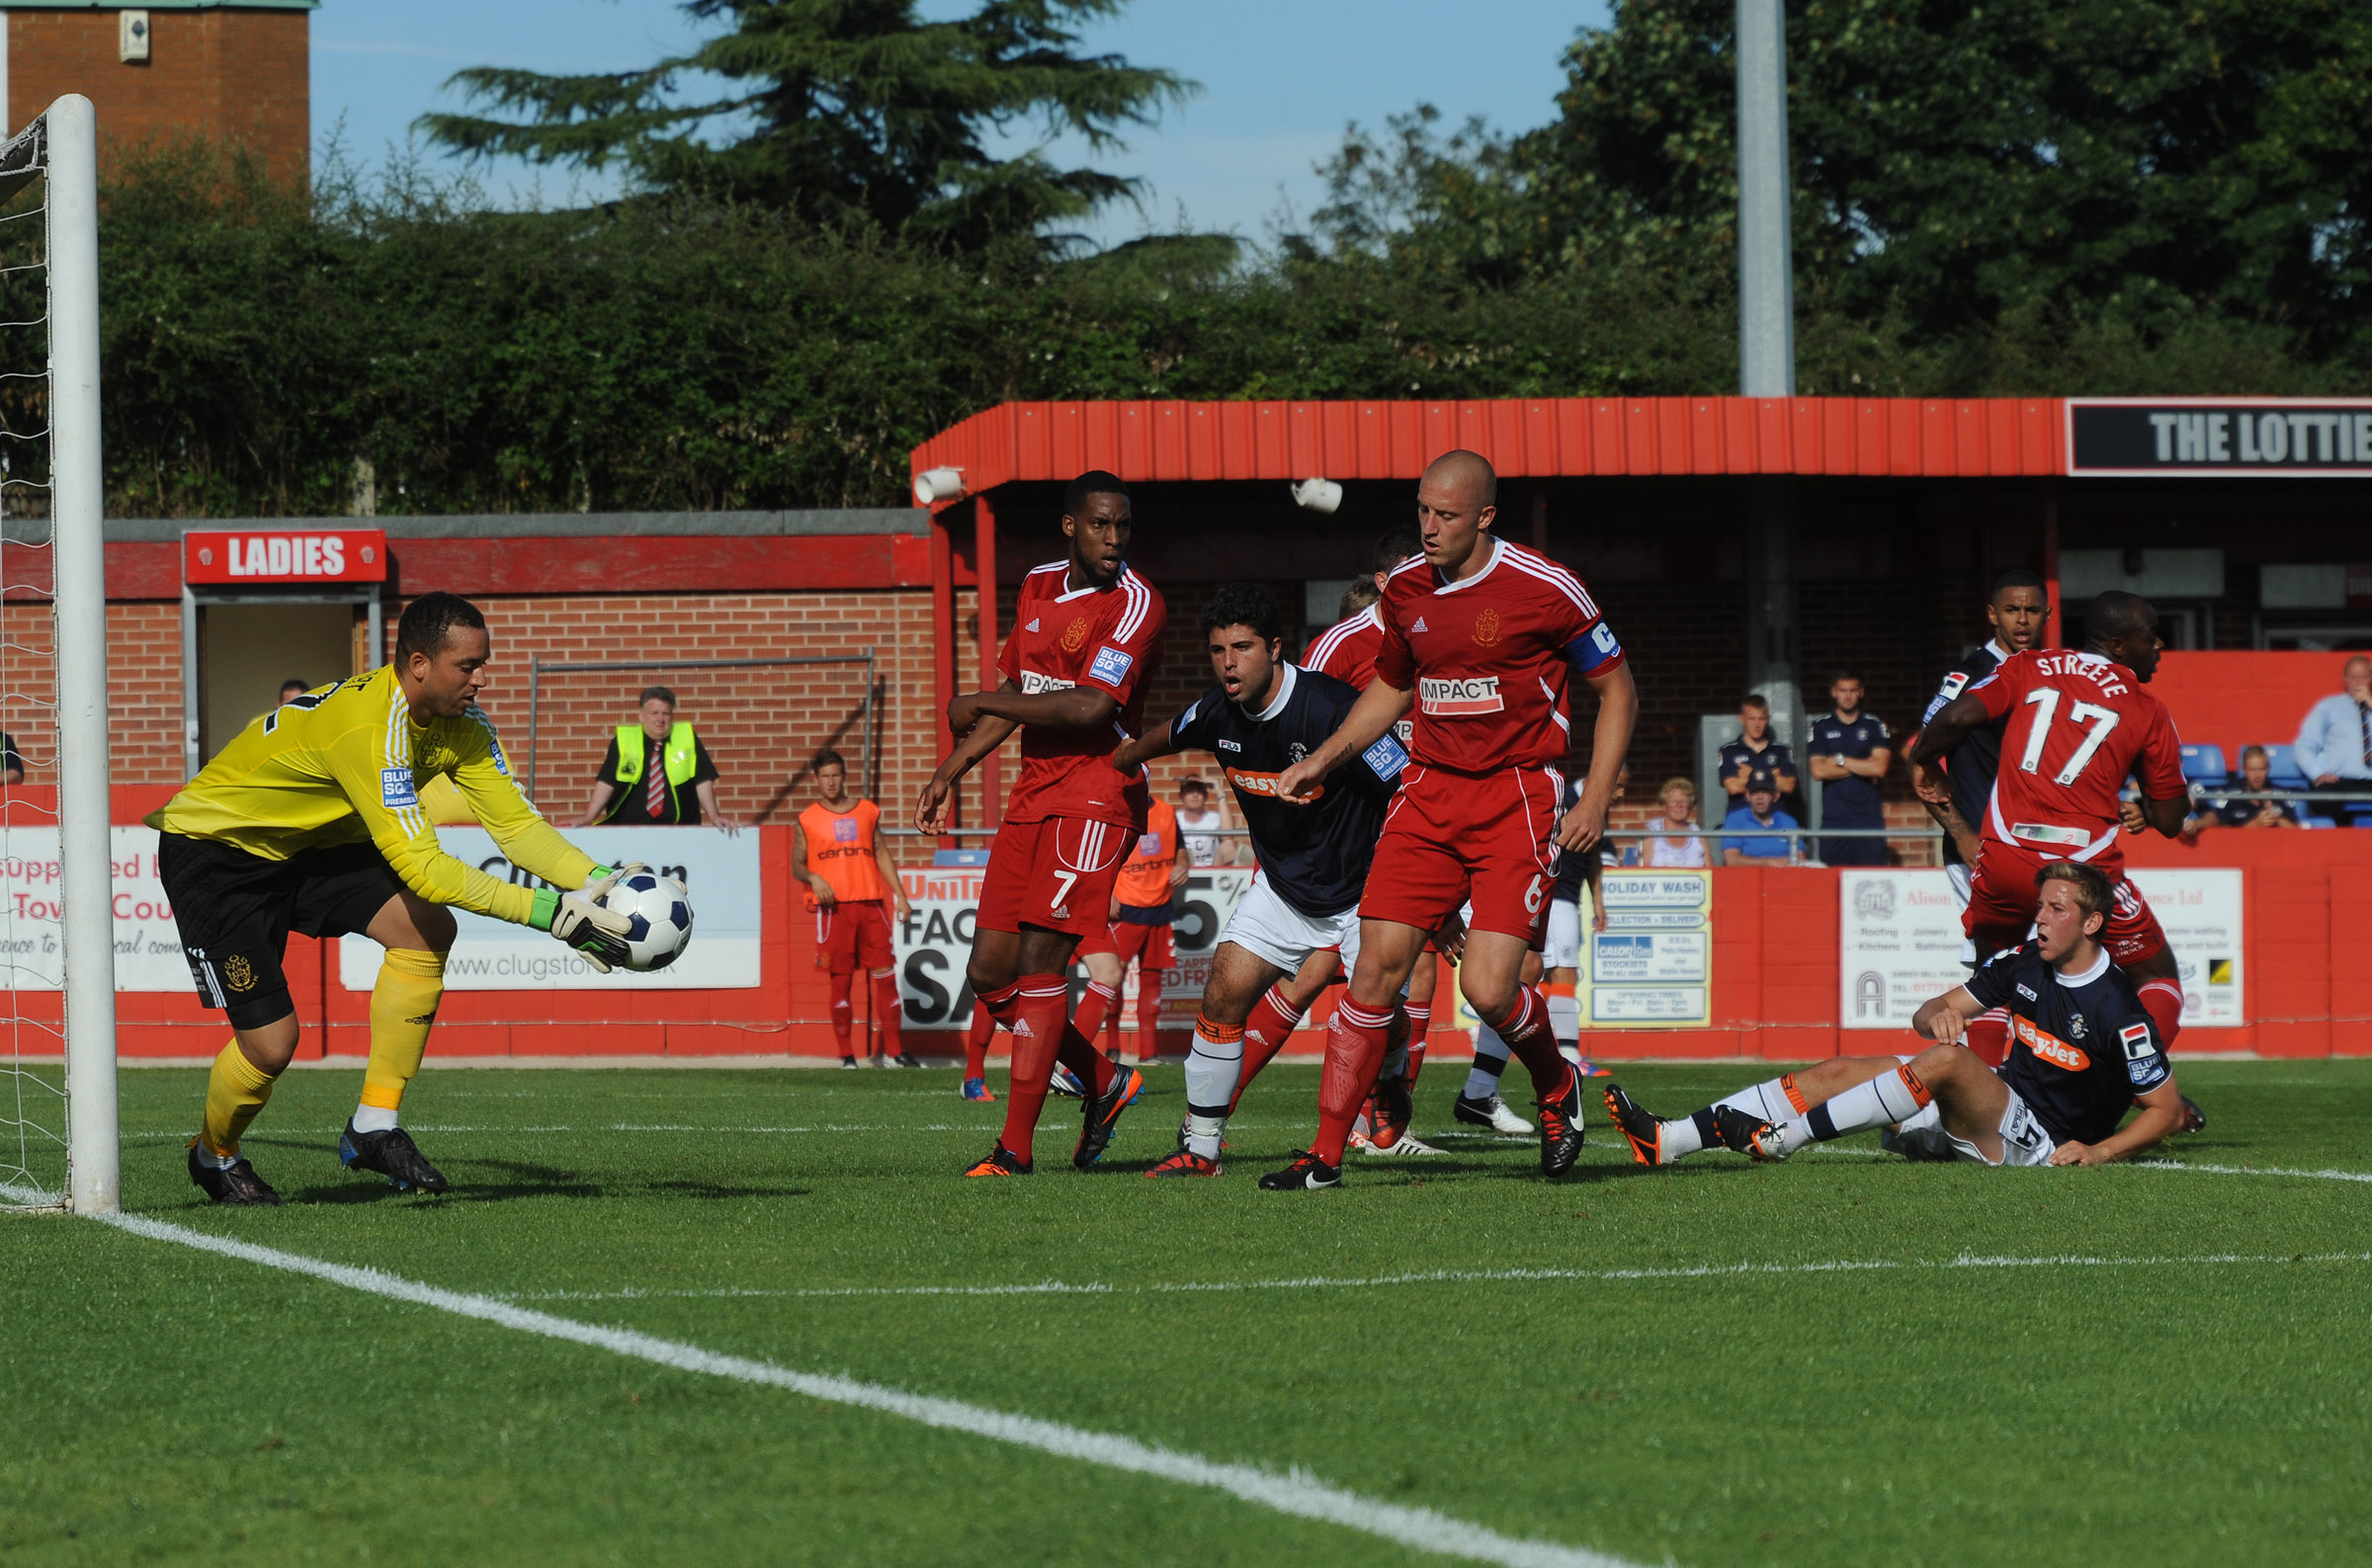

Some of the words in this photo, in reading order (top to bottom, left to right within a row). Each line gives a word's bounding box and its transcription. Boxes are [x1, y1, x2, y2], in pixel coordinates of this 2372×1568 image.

[2149, 413, 2230, 461] THE
[2238, 413, 2372, 462] LOTTIE
[228, 536, 345, 576] LADIES
[1591, 621, 1615, 653] C
[1100, 649, 1130, 667] BLUE
[1091, 668, 1118, 685] PREMIER
[2037, 654, 2128, 698] STREETE
[1421, 680, 1496, 700] IMPACT
[2024, 687, 2120, 787] 17
[1365, 736, 1393, 763] BLUE
[1381, 754, 1406, 779] PREMIER
[1051, 869, 1077, 909] 7
[1524, 873, 1542, 914] 6
[1662, 882, 1701, 894] WASH
[1906, 890, 1951, 906] Alison
[2178, 889, 2203, 905] Ltd
[1661, 916, 1700, 925] DELIVERY
[1861, 928, 1899, 938] Roofing
[1913, 928, 1948, 938] Joinery
[1859, 942, 1901, 951] Kitchens
[2018, 984, 2036, 1000] FILA
[2018, 1022, 2080, 1067] eayJet
[2130, 1057, 2159, 1071] BLUE
